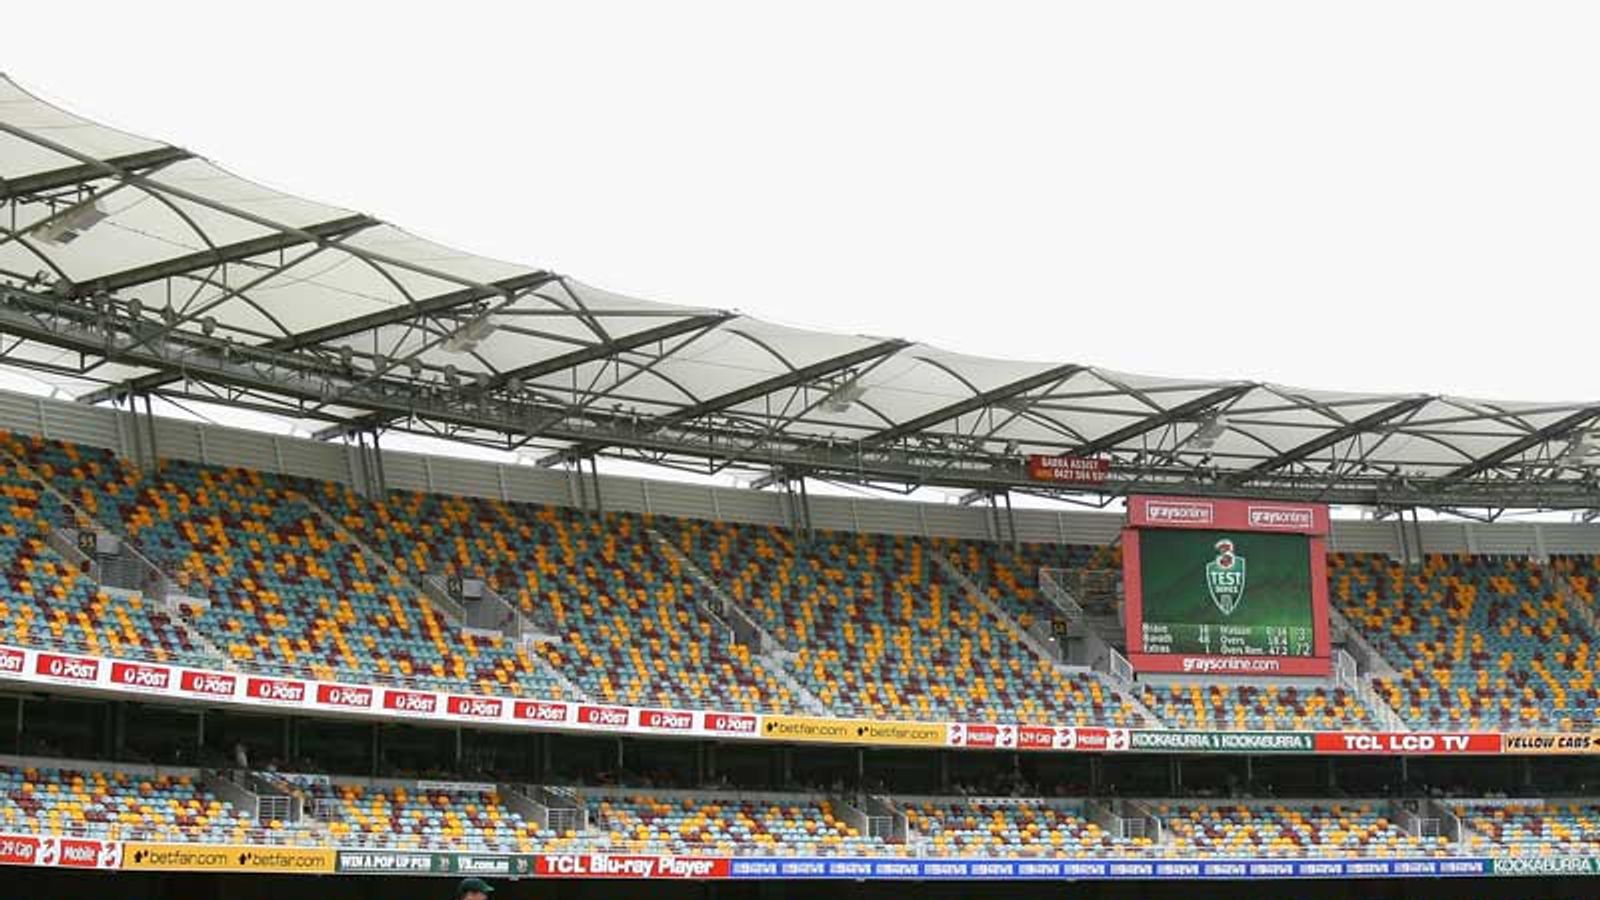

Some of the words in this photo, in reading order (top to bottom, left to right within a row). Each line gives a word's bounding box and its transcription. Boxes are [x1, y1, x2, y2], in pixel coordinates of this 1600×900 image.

[1149, 506, 1209, 519] graysonline
[1252, 511, 1309, 524] graysonline
[1210, 572, 1241, 585] TEST
[64, 662, 97, 679] POST
[1183, 658, 1280, 670] graysonline.com
[136, 670, 169, 688] POST
[204, 680, 235, 695] POST
[272, 684, 304, 700] POST
[340, 692, 370, 707] POST
[407, 698, 434, 712] POST
[472, 702, 501, 716] POST
[537, 705, 566, 720] POST
[600, 710, 628, 724] POST
[662, 714, 691, 729] POST
[727, 718, 754, 731] POST
[779, 721, 848, 736] betfair.com
[870, 726, 939, 740] betfair.com
[1132, 734, 1210, 748] KOOKABURRA
[1221, 735, 1300, 748] KOOKABURRA
[1344, 736, 1383, 750] TCL
[1390, 736, 1435, 750] LCD
[1441, 736, 1470, 750] TV
[1507, 736, 1554, 748] YELLOW
[1558, 736, 1591, 748] CABS
[64, 846, 96, 861] Mobile
[150, 850, 228, 866] betfair.com
[252, 852, 325, 868] betfair.com
[340, 855, 362, 869] WIN
[374, 855, 394, 868] POP
[396, 855, 410, 868] UP
[545, 856, 586, 873] TCL
[590, 856, 654, 878] Blu-ray
[658, 856, 714, 878] Player
[1494, 858, 1590, 874] KOOKABURRA
